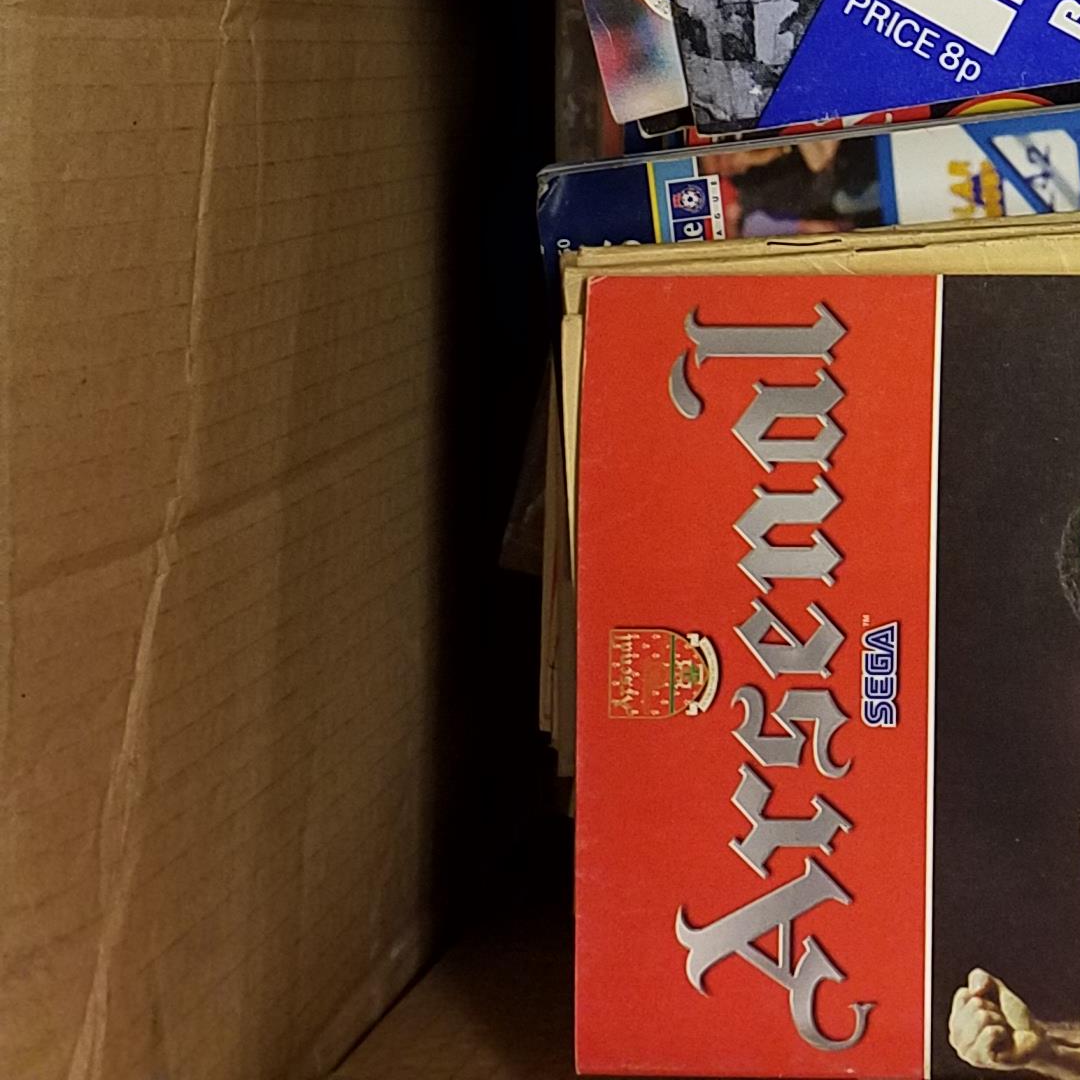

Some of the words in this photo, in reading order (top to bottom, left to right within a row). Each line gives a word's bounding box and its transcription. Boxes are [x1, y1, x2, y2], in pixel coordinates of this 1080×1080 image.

[938, 41, 981, 83] 8p
[667, 300, 876, 1052] Arsenal
[861, 621, 898, 727] SEGA
